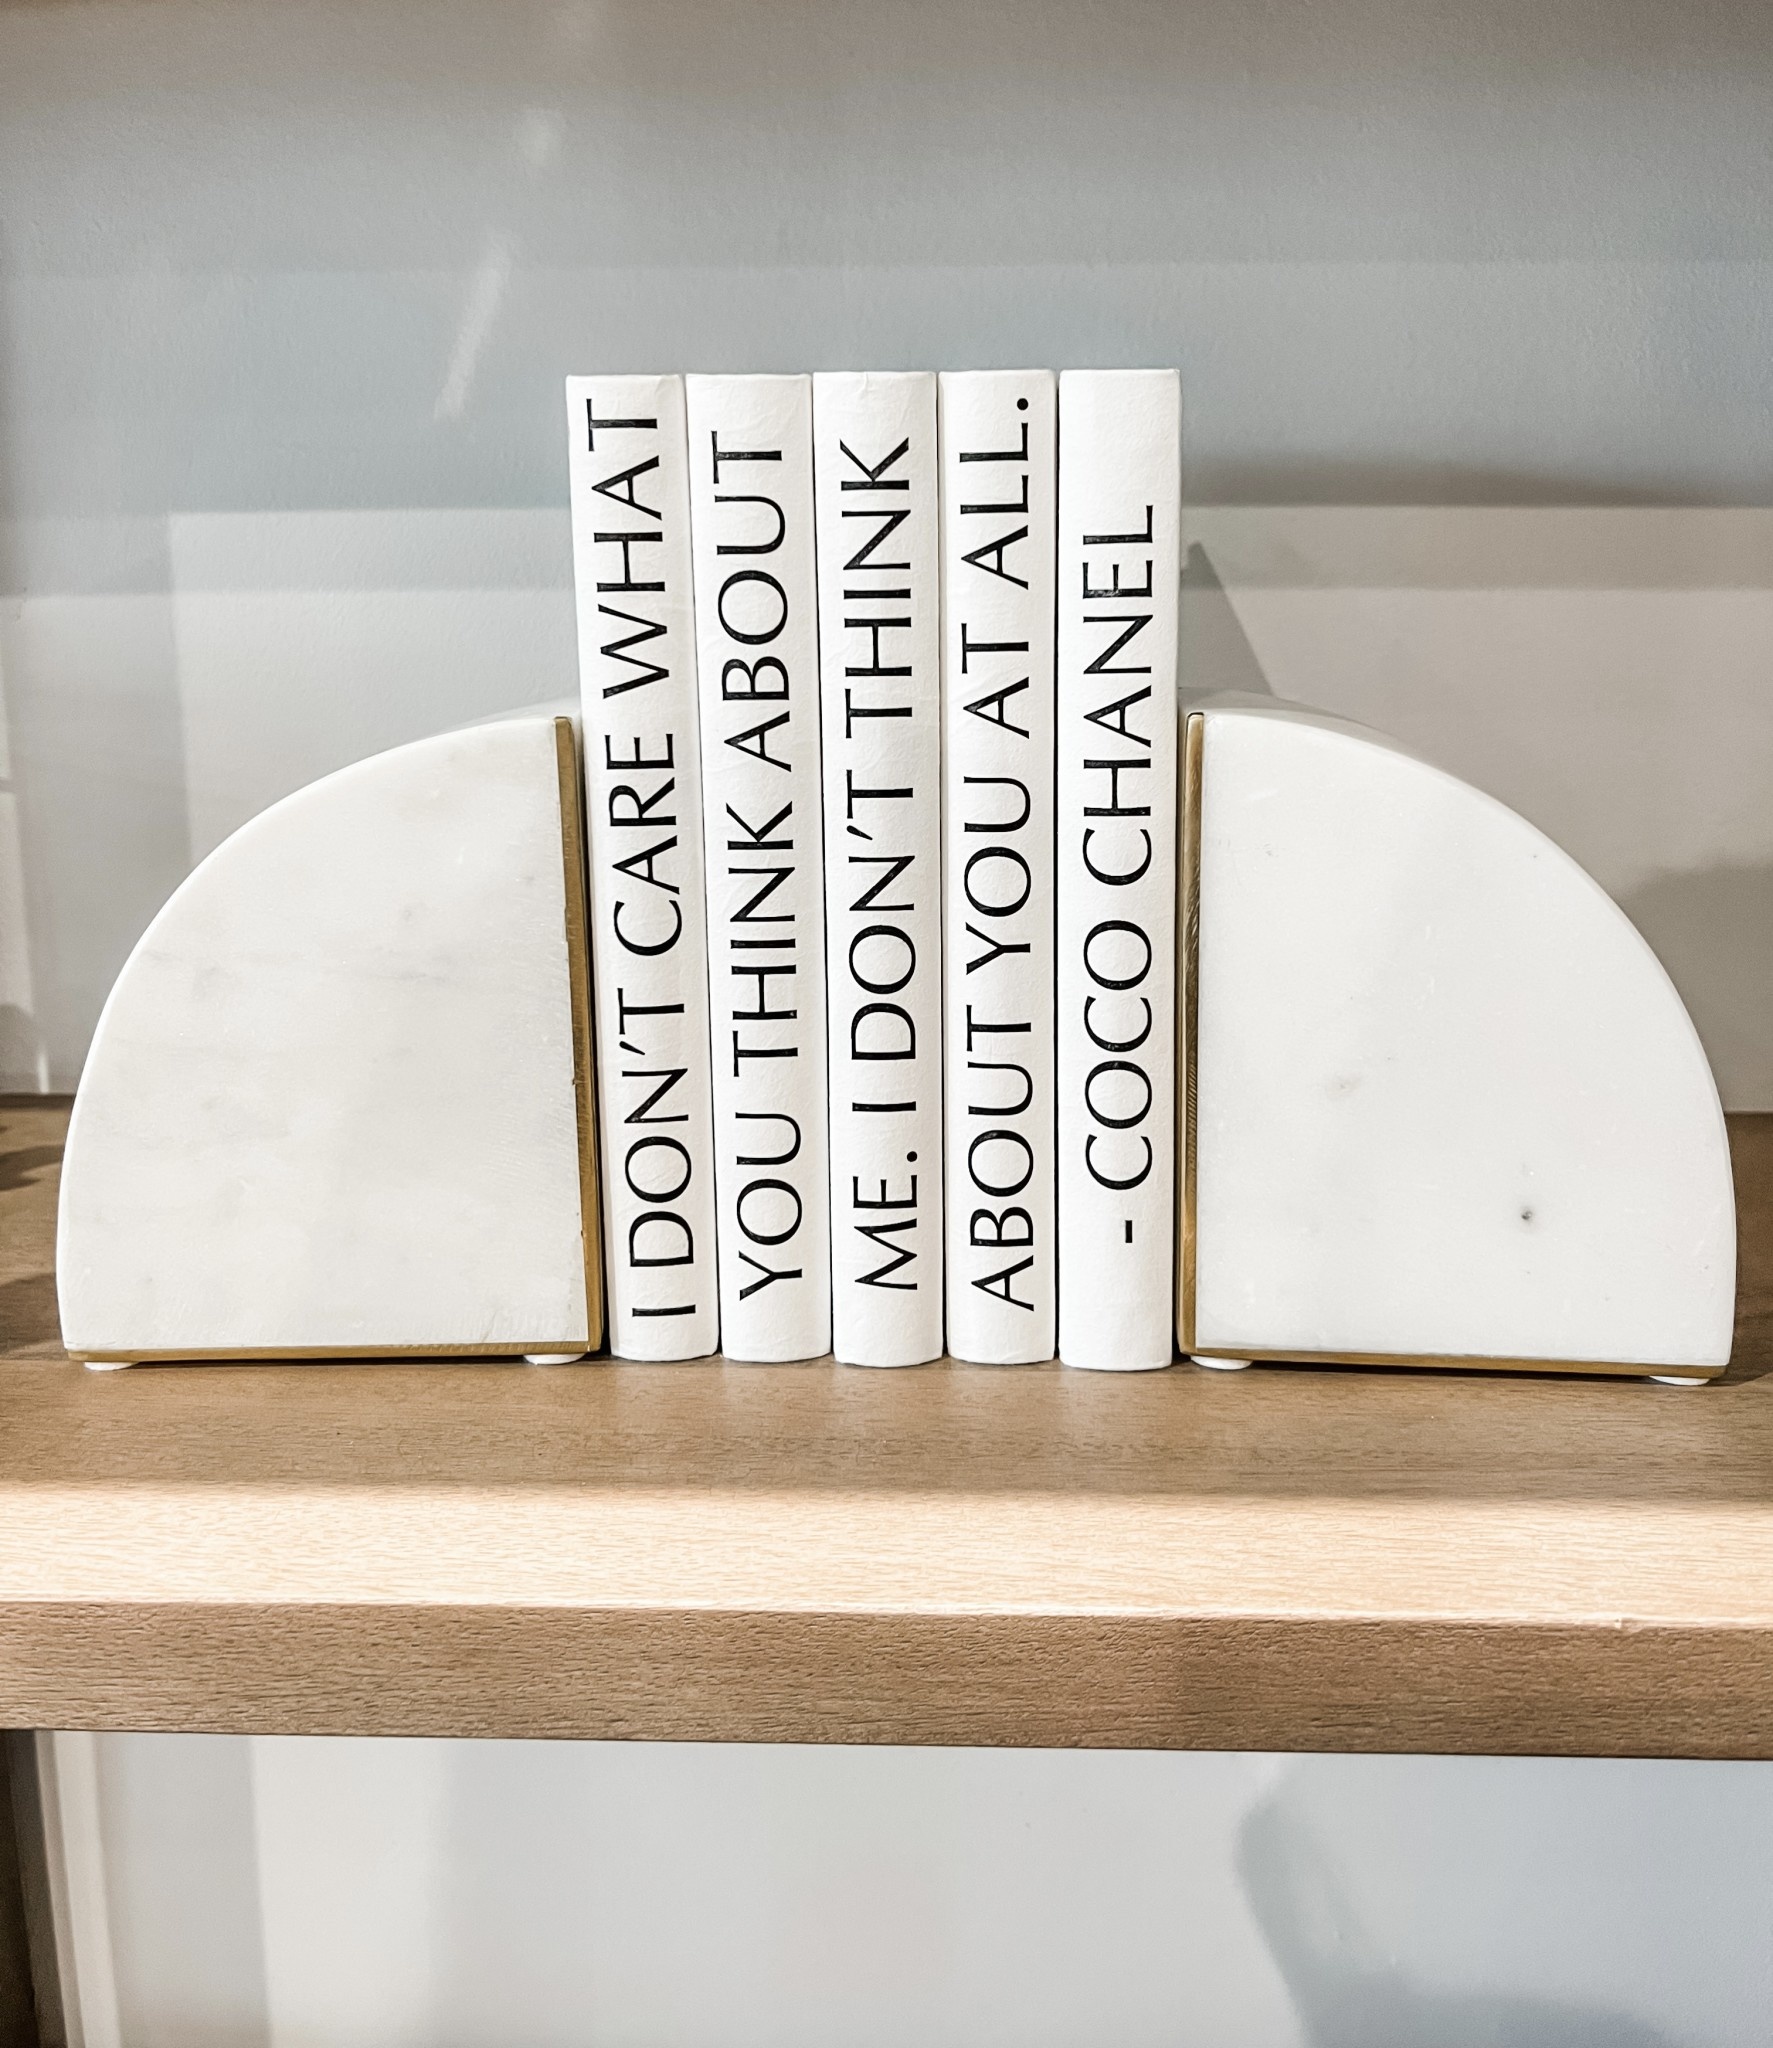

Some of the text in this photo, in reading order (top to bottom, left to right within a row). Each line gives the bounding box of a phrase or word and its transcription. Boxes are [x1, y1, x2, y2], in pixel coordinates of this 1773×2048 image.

[586, 398, 696, 1317] I DON'T CARE WHAT
[711, 430, 803, 1301] YOU THINK ABOUT
[839, 437, 918, 1291] ME. I DON'T THINK
[959, 397, 1035, 1312] ABOUT YOU AT ALL.
[1082, 505, 1154, 886] CHANEL
[1083, 919, 1153, 1191] COCO
